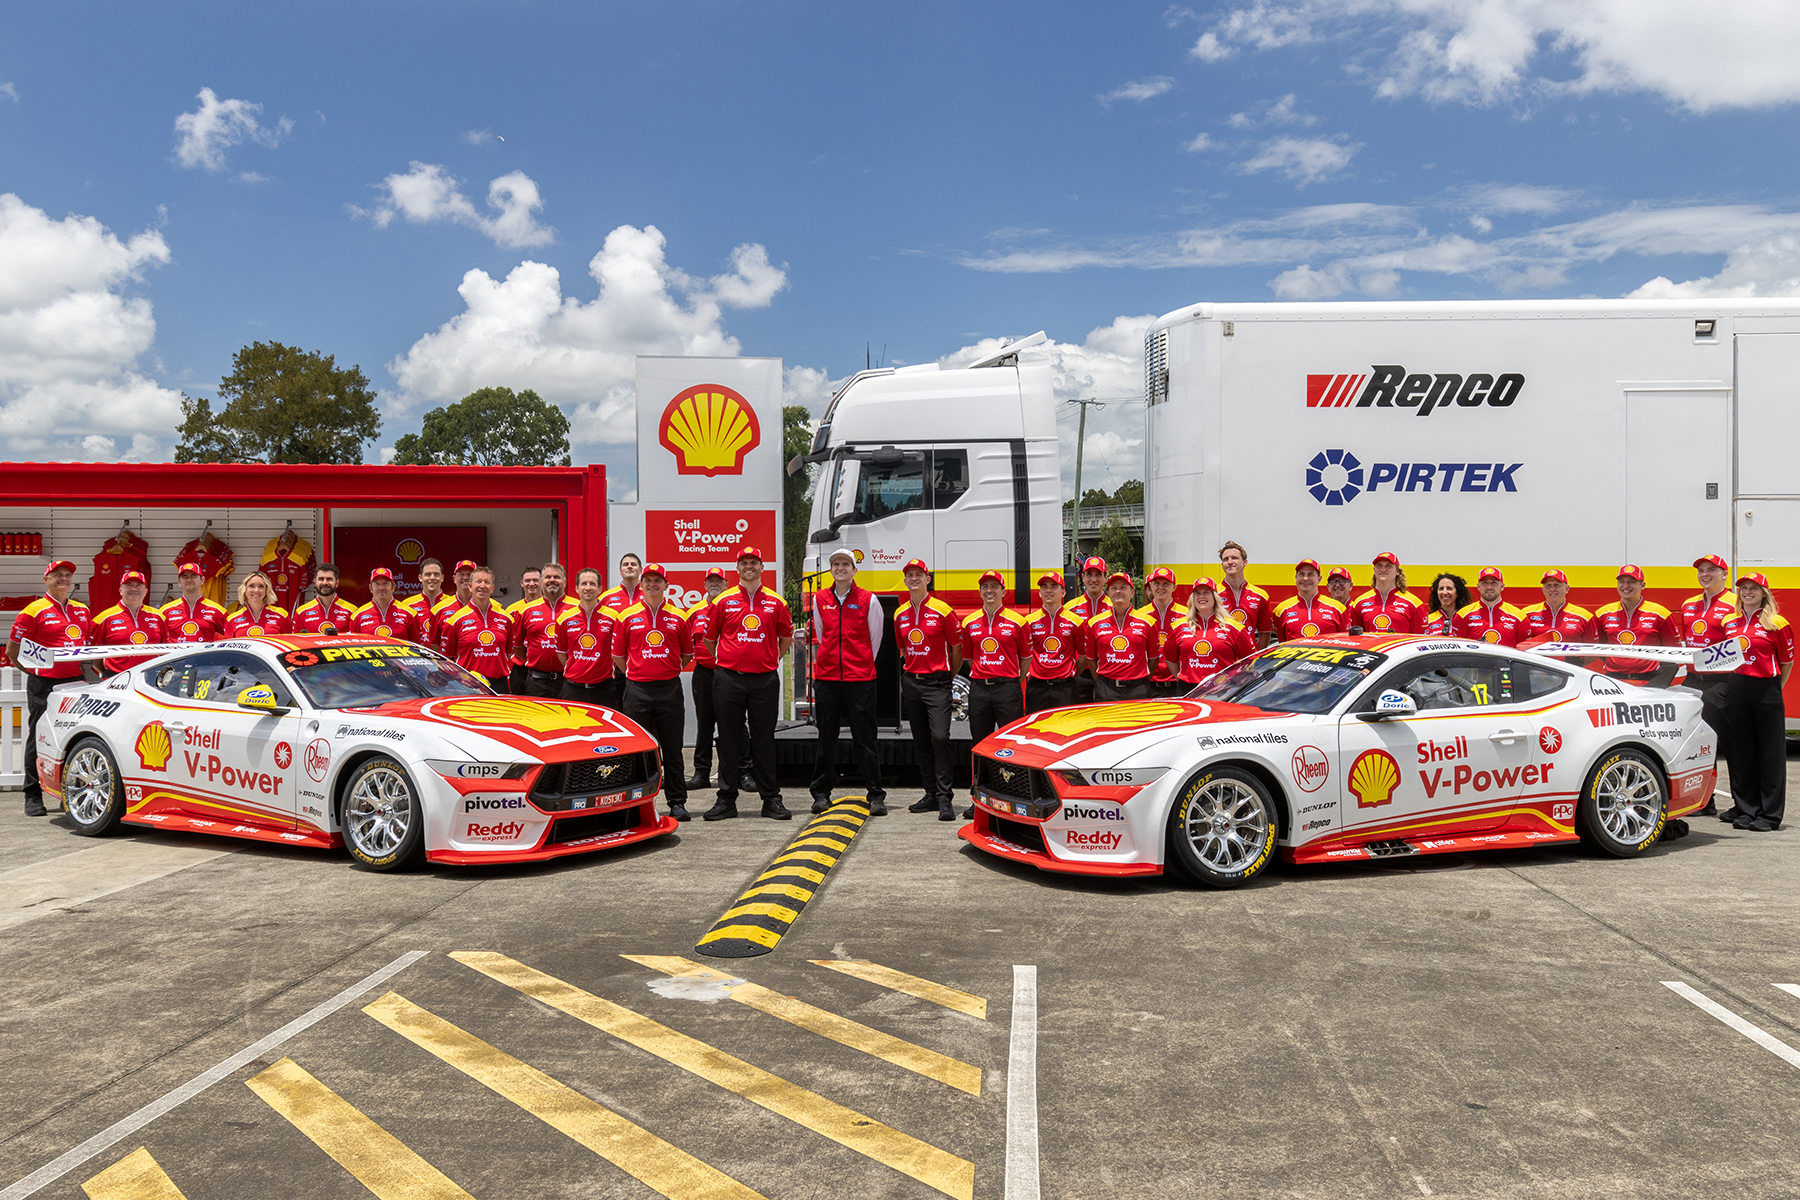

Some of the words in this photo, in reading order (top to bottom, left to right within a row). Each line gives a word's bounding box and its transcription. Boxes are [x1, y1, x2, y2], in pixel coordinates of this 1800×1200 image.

[1355, 364, 1525, 416] Repco
[1366, 463, 1524, 492] PIRTEK
[674, 519, 700, 529] Shell
[674, 531, 743, 544] V-Power
[679, 545, 705, 554] Racing
[321, 646, 420, 662] PIRTEK
[1262, 647, 1358, 664] PIRTEK
[1593, 645, 1695, 656] TECHNOLOG
[1702, 640, 1736, 664] DXC
[1297, 661, 1333, 674] Davison
[1706, 656, 1738, 671] TECHNOLOGY
[194, 680, 211, 699] 38
[1471, 683, 1489, 705] 17
[68, 693, 121, 718] Repco
[1612, 702, 1676, 727] Repco
[183, 725, 221, 750] Shell
[1639, 729, 1656, 738] Gets
[1656, 730, 1669, 739] you
[1417, 735, 1468, 764] Shell
[184, 750, 283, 796] V-Power
[366, 761, 406, 775] DUNLOP
[468, 764, 499, 777] mps
[1295, 748, 1327, 784] Rheem
[1102, 771, 1133, 784] mps
[1418, 762, 1554, 799] V-Power
[1591, 770, 1602, 800] SPORT
[1601, 754, 1620, 773] MAXX
[1684, 774, 1703, 788] FORD
[303, 790, 325, 800] DUNLOP
[1179, 774, 1212, 820] DUNLOP
[1302, 802, 1337, 813] DUNLOP
[1554, 805, 1572, 818] PPG
[467, 821, 525, 839] Reddy
[1308, 818, 1331, 830] Repco
[1638, 811, 1666, 850] DUNLOP
[1066, 830, 1122, 850] Reddy
[1264, 823, 1275, 857] SPORT
[1244, 854, 1266, 878] MAXX
